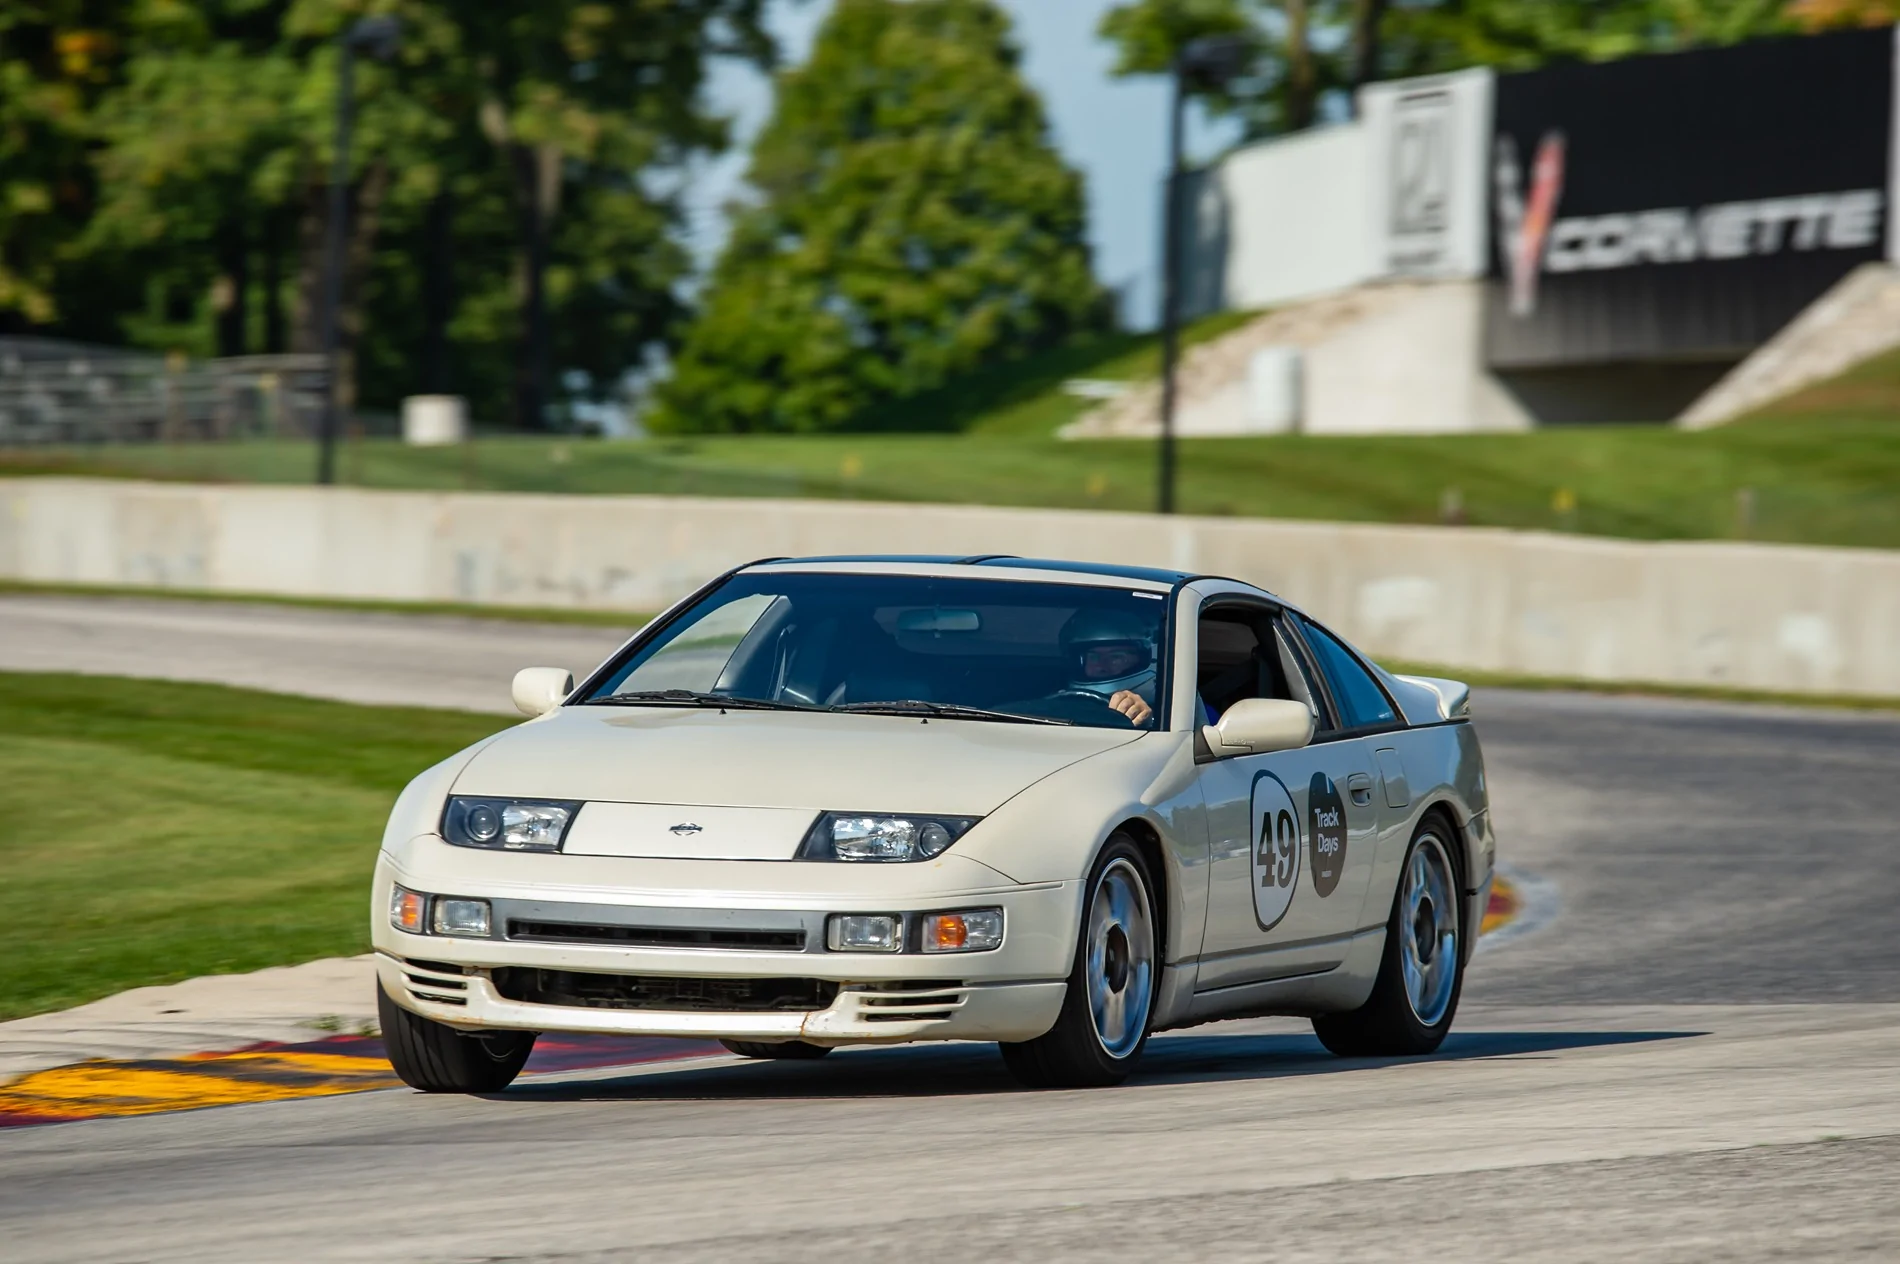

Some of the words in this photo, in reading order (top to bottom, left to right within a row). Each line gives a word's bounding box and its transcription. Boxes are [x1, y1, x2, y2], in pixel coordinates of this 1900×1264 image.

[1547, 189, 1881, 273] CORVETTE
[1314, 807, 1339, 828] Track
[1257, 809, 1296, 888] 49
[1318, 833, 1339, 857] Days
